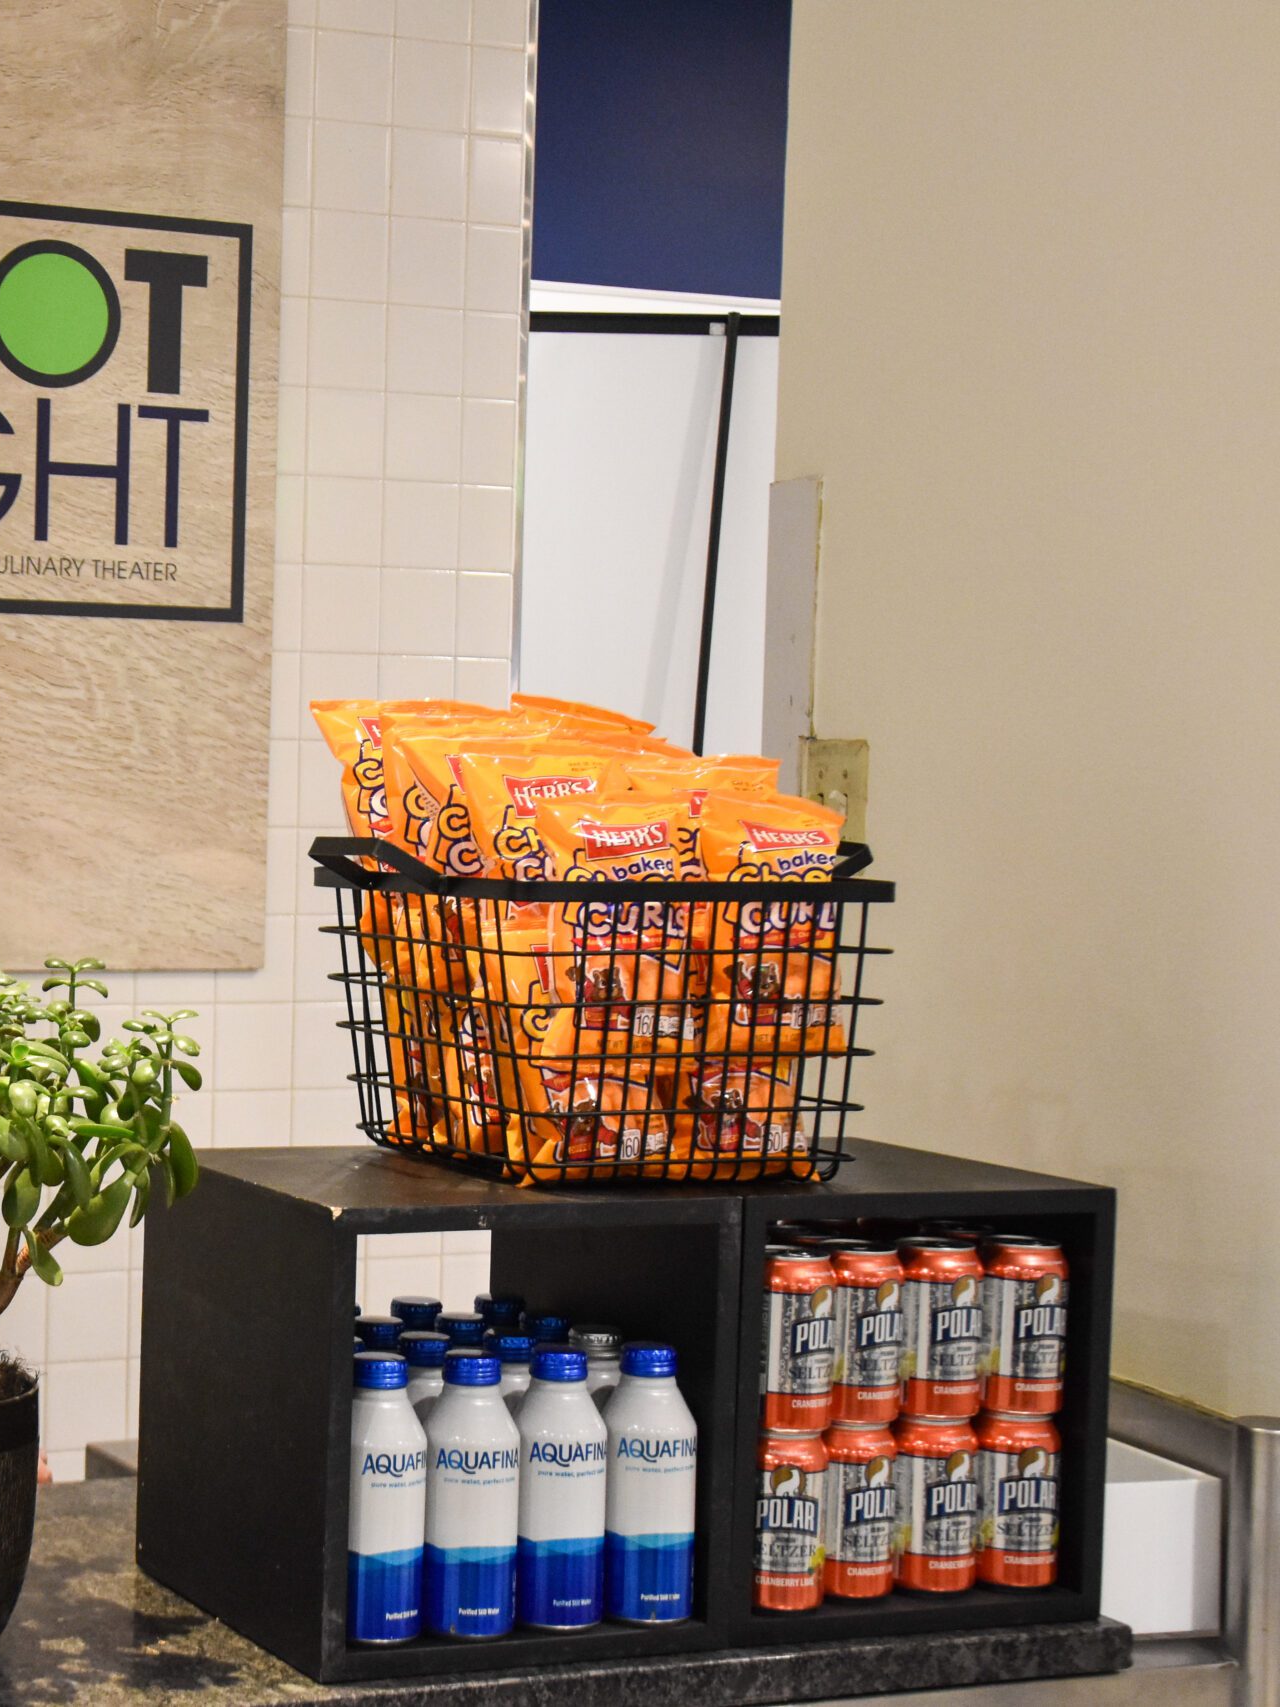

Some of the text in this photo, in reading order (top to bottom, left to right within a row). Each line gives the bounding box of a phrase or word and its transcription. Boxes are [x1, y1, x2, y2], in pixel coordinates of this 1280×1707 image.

[92, 559, 178, 581] THEATER
[592, 824, 665, 848] HERR'S
[752, 828, 825, 846] HERR'S
[436, 1447, 519, 1474] AQUAFINA
[756, 1499, 815, 1532] POLAR
[755, 1576, 799, 1587] CRANBERRY
